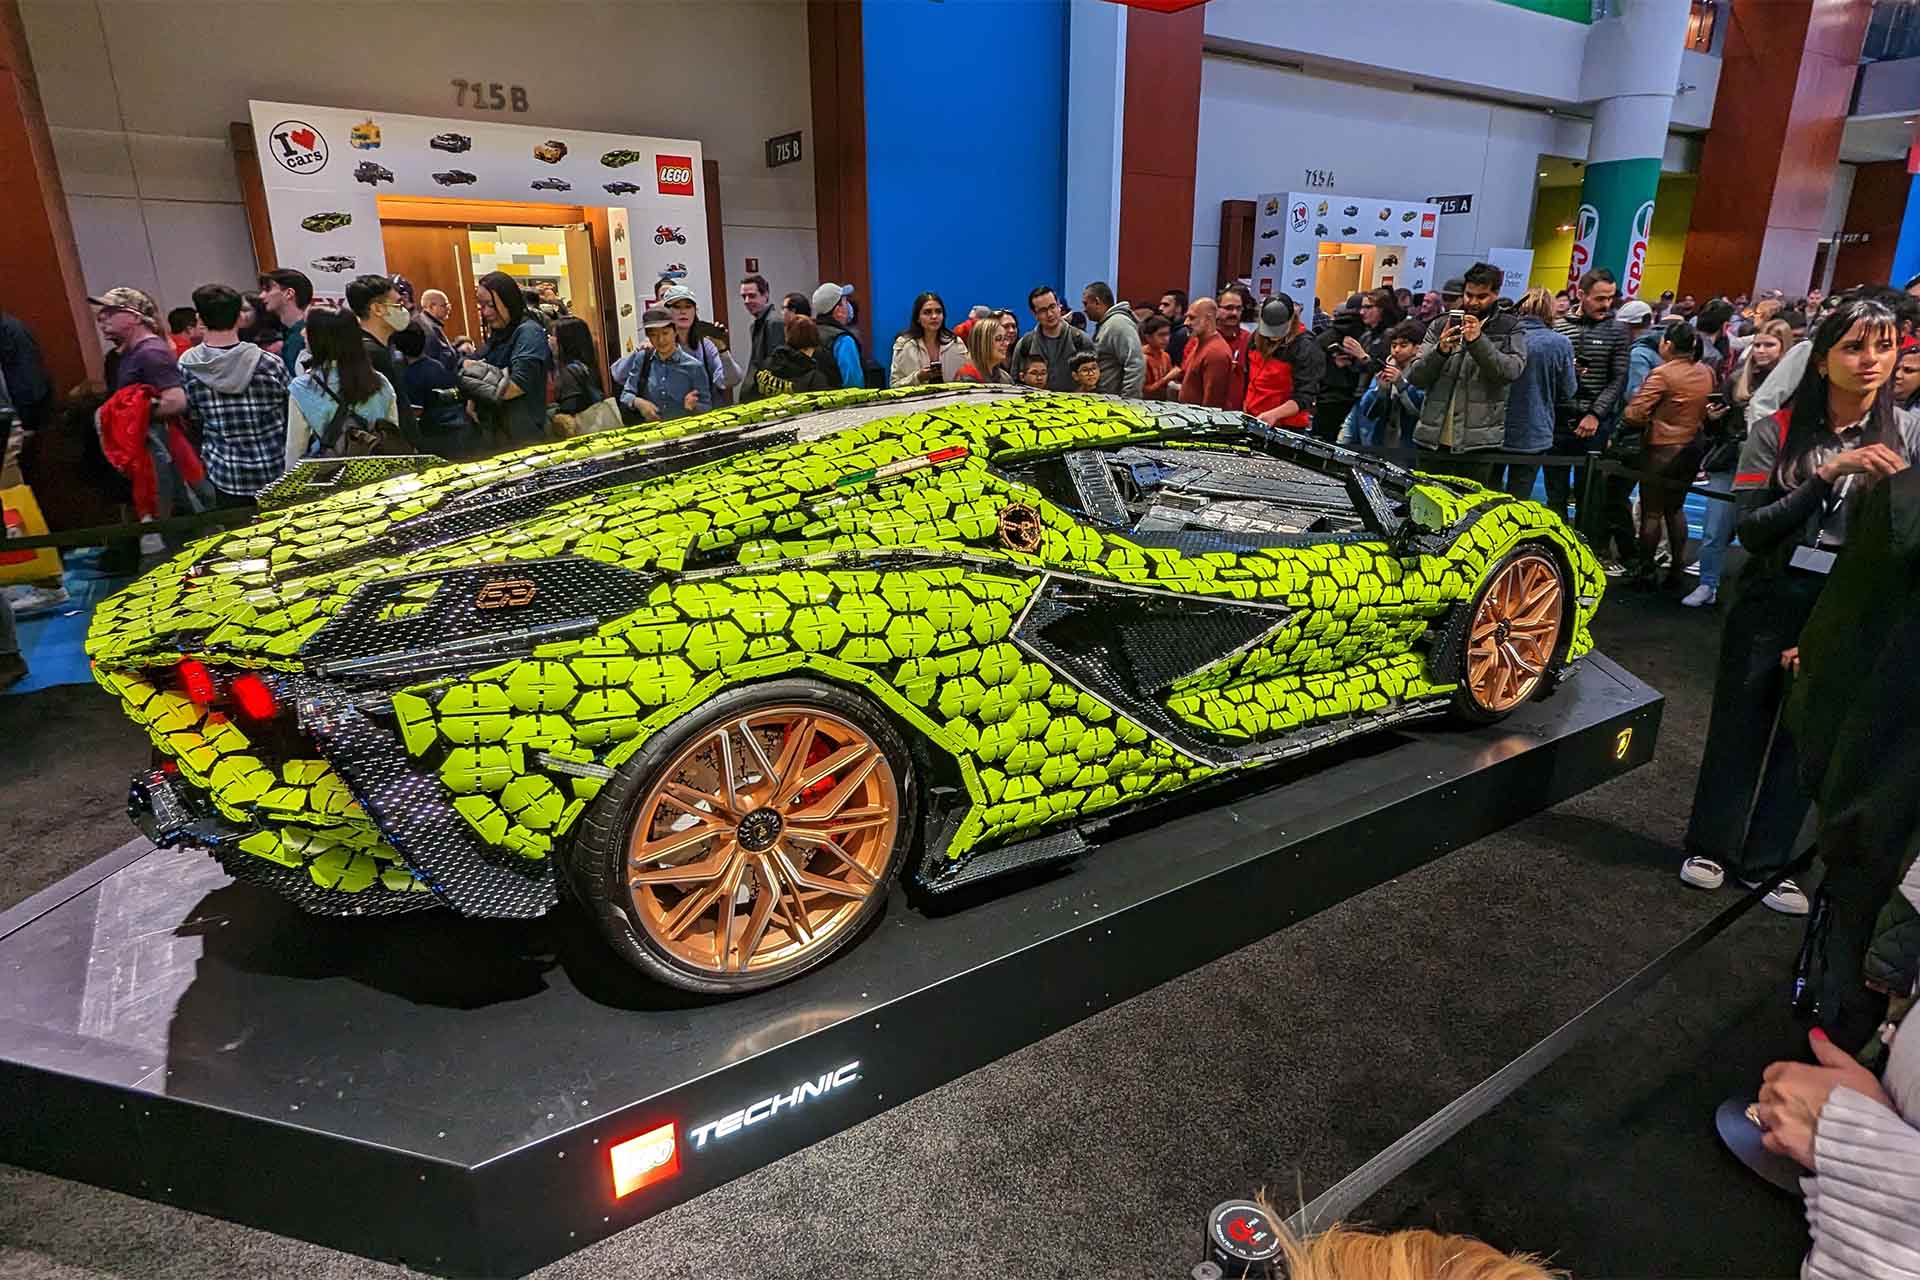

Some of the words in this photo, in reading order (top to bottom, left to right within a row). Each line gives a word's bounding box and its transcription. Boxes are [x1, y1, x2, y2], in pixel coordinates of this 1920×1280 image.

[273, 132, 298, 157] I
[287, 151, 323, 168] cars
[776, 143, 790, 161] 715
[792, 140, 799, 158] B
[660, 167, 690, 184] LEGO
[1439, 200, 1457, 212] 715
[1460, 199, 1469, 211] A
[690, 1060, 860, 1147] TECHNIC
